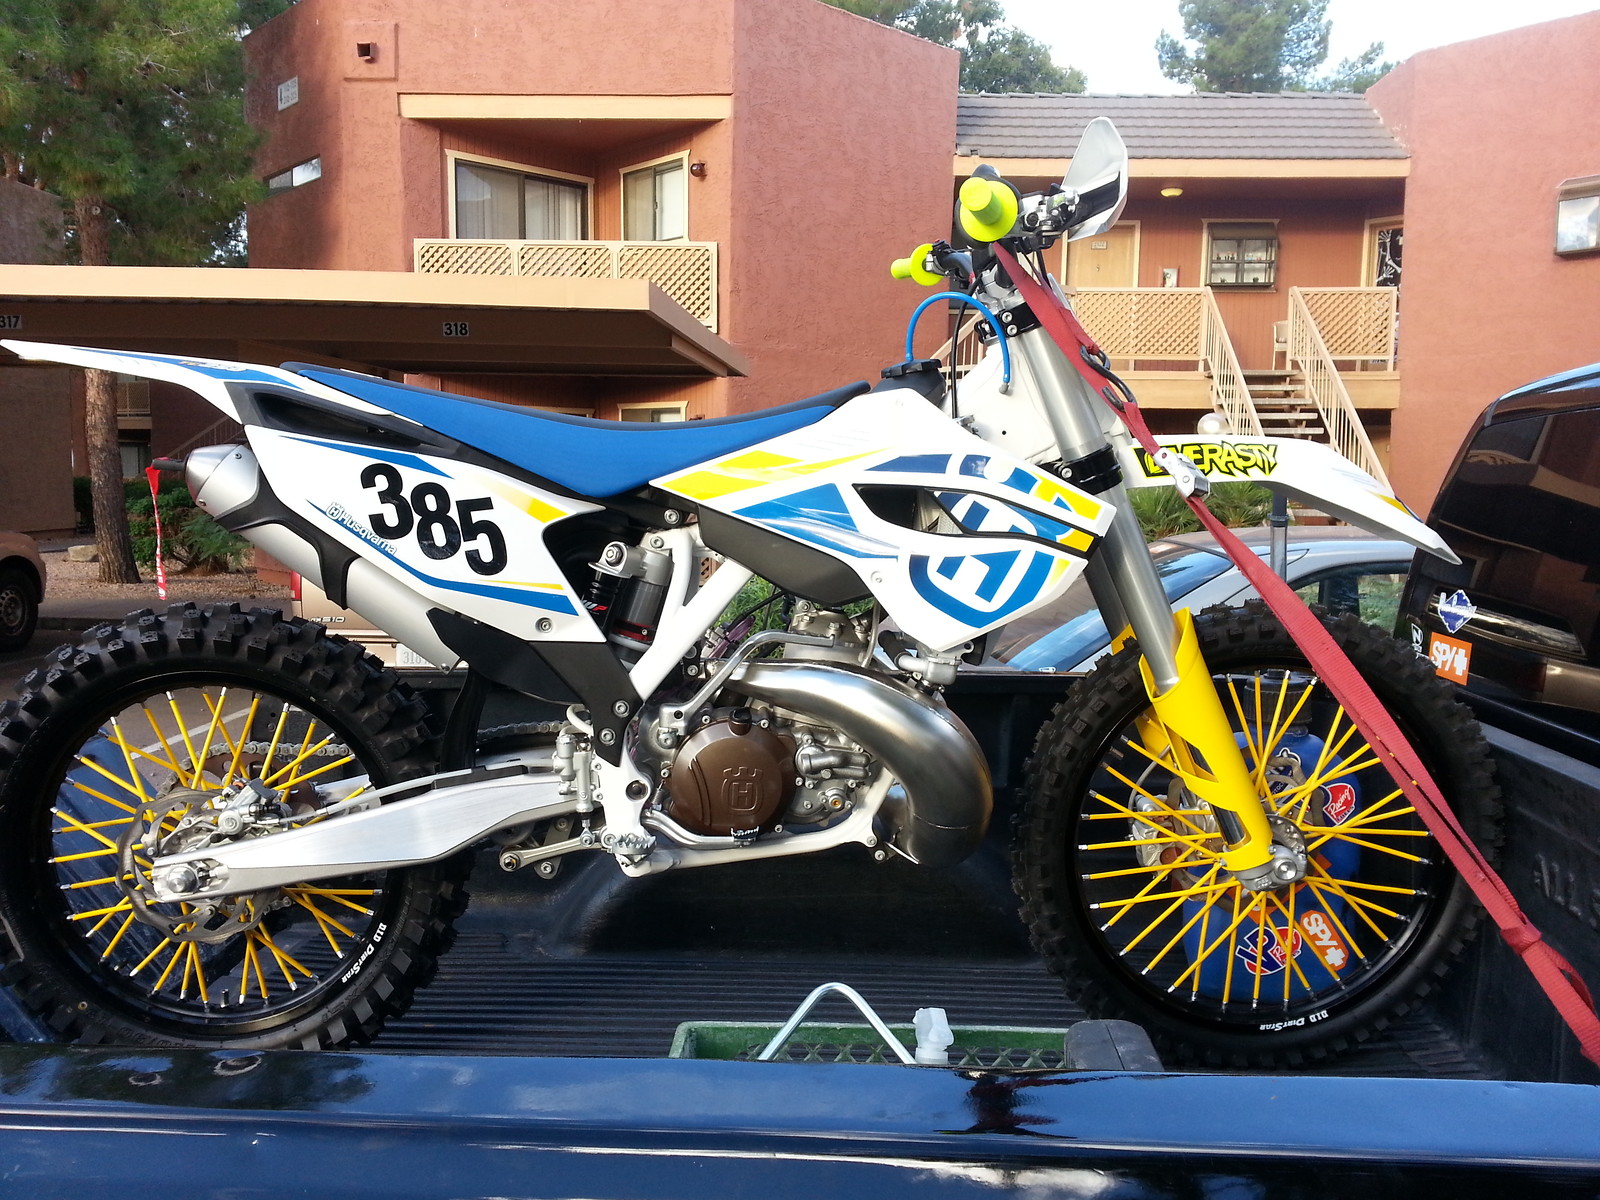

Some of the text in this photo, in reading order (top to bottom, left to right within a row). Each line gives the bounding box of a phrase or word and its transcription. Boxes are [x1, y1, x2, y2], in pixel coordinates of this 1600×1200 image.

[0, 315, 20, 329] 317
[444, 322, 468, 336] 318
[337, 507, 398, 556] Husqvarna
[360, 463, 508, 576] 385
